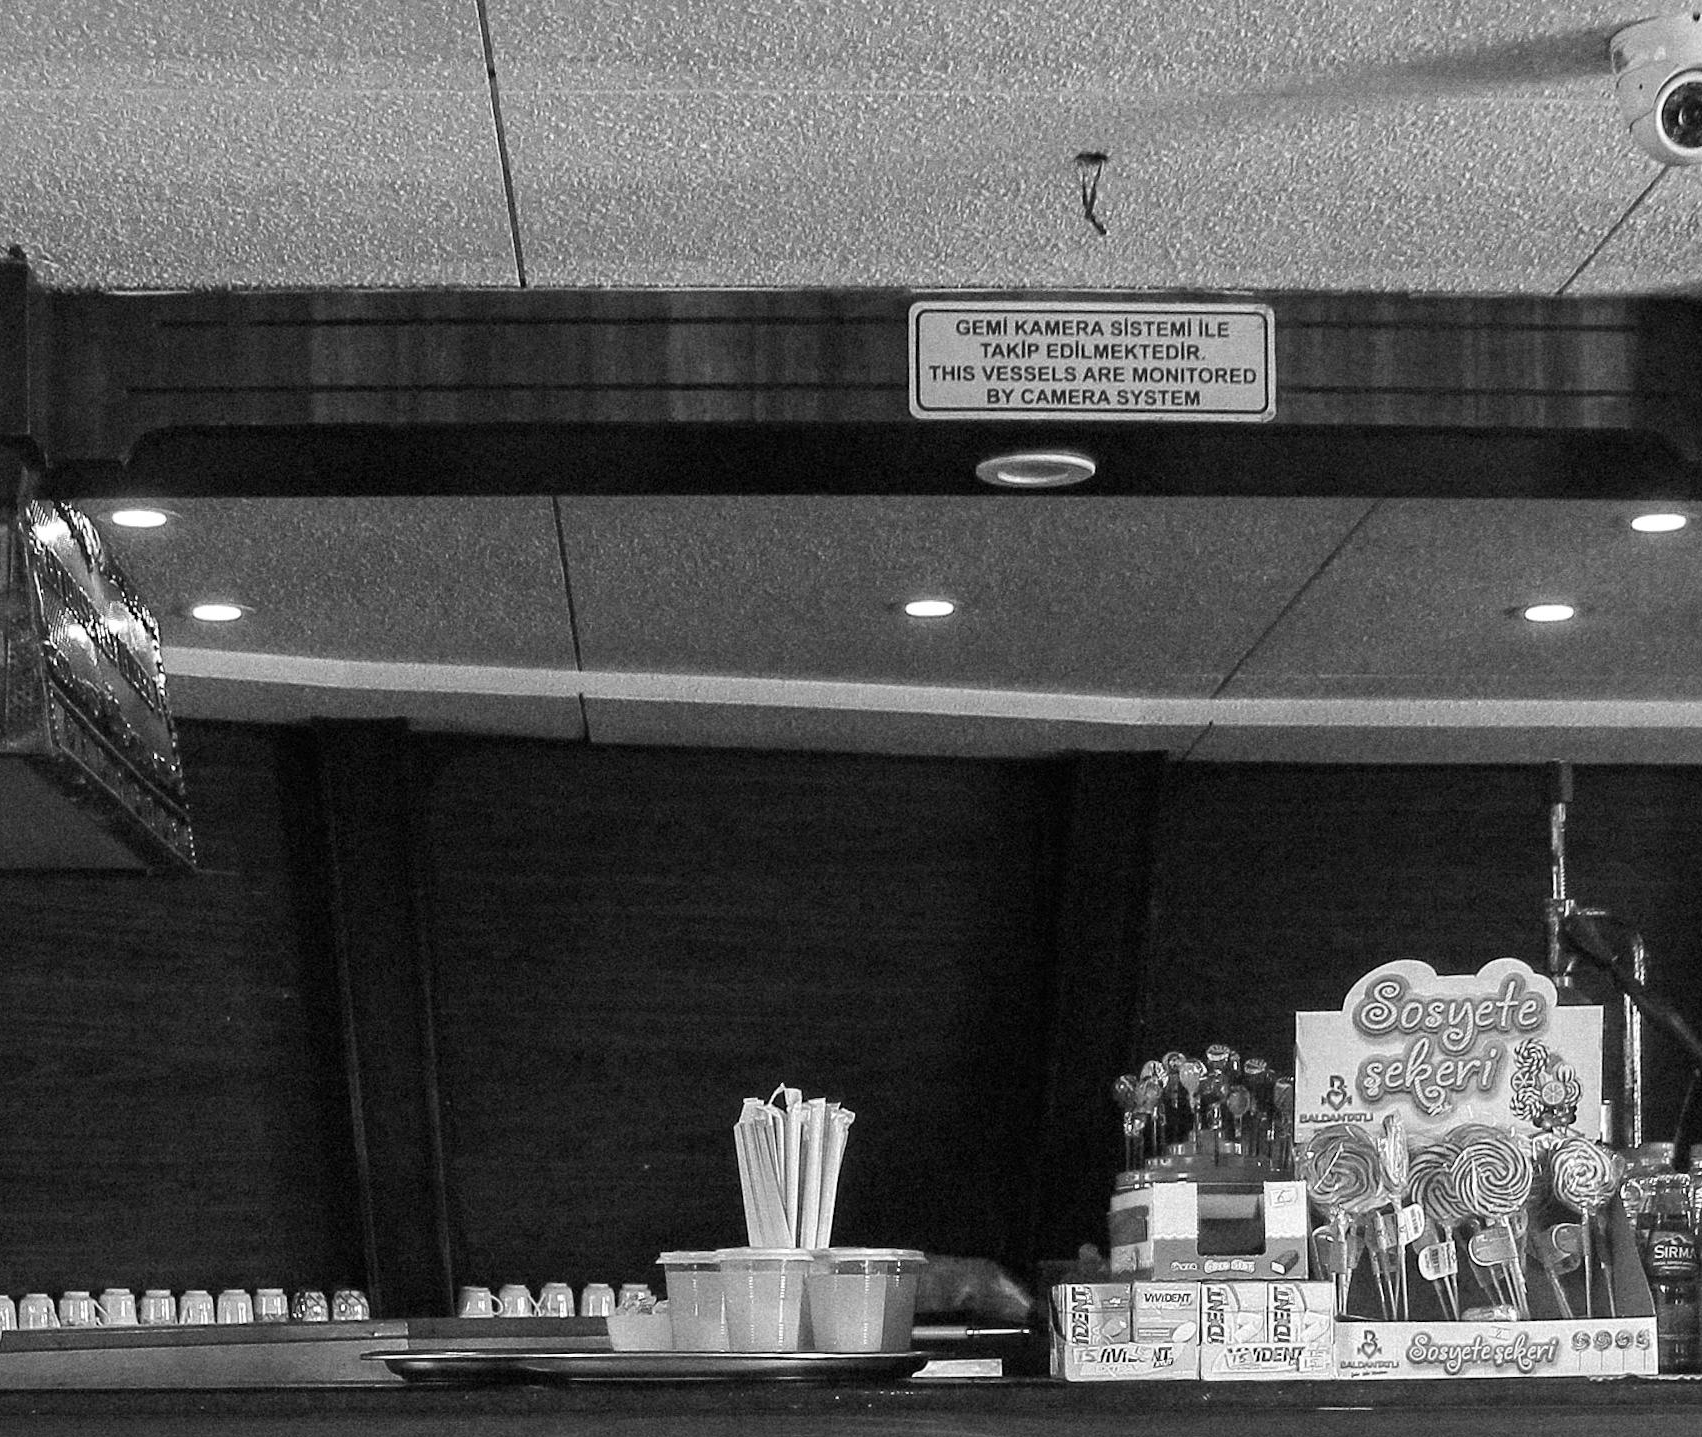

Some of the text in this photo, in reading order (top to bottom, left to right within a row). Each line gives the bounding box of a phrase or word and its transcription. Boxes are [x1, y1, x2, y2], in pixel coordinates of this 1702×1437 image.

[955, 317, 1230, 339] GEMİ KAMERA SİSTEMİ İLE
[980, 340, 1206, 362] TAKİP EDİLMEKTEDİR.
[929, 365, 1257, 385] THIS VESSELS ARE MONITORED
[986, 389, 1202, 407] BY CAMERA SYSTEM
[1359, 980, 1539, 1055] Sosyete
[1361, 1037, 1497, 1116] şekeri
[1410, 1332, 1556, 1373] Sosyete şekeri
